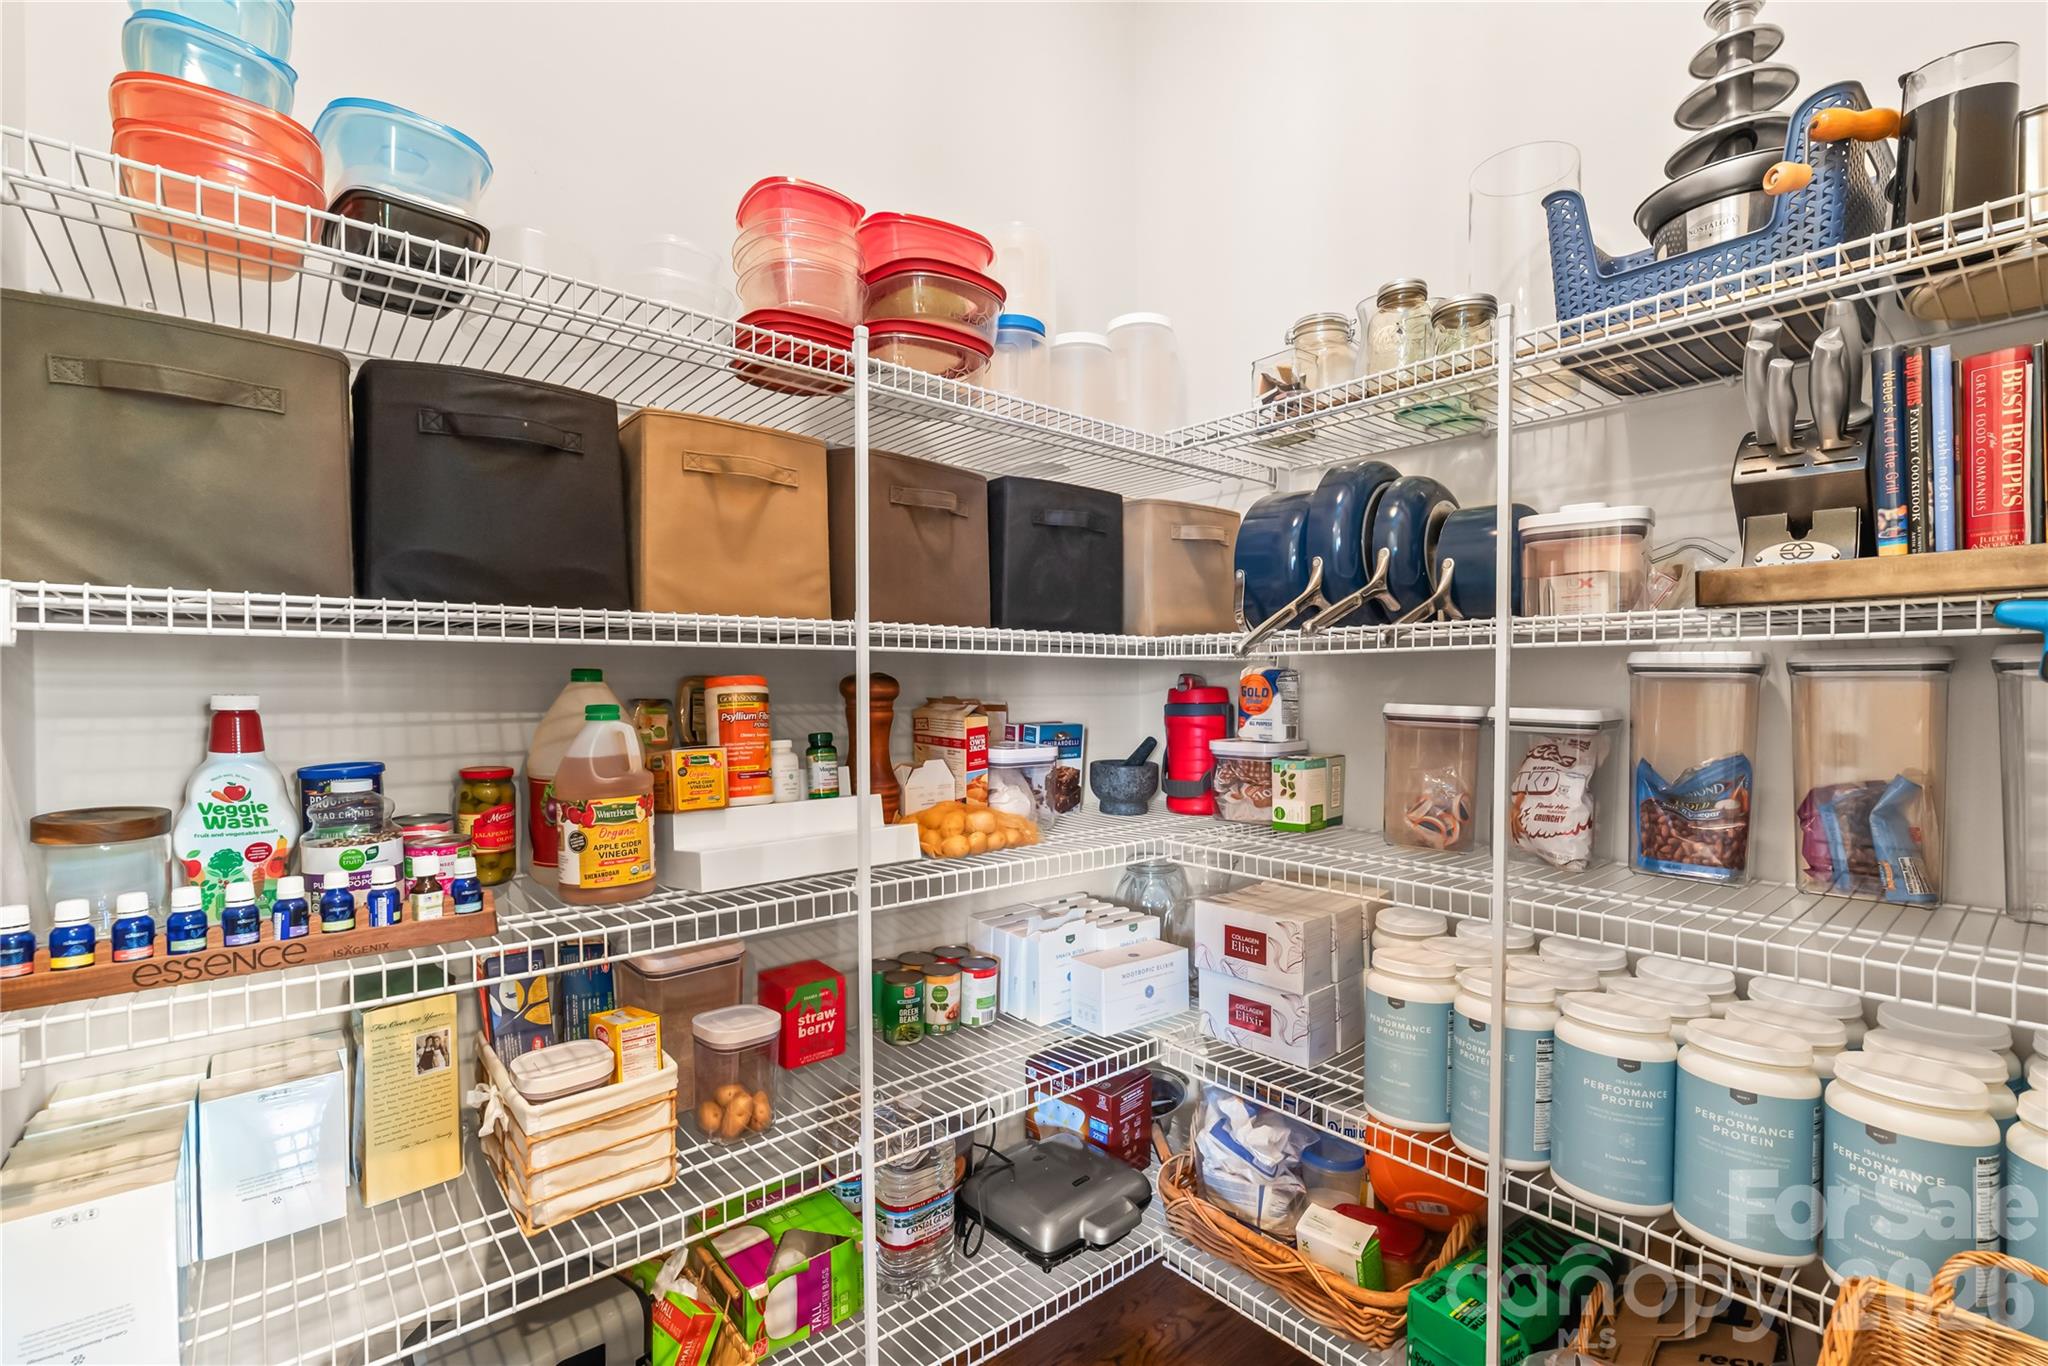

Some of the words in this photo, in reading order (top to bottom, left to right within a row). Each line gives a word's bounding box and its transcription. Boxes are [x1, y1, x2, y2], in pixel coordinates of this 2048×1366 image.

[1688, 215, 1738, 236] NOSTALGIA
[1882, 370, 1896, 414] Weber's
[1975, 374, 1987, 408] GREAT
[2001, 368, 2024, 417] BEST
[1883, 417, 1898, 435] Art
[1909, 408, 1921, 452] FAMILY
[1976, 413, 1987, 444] FOOD
[1884, 439, 1898, 450] of
[1938, 430, 1948, 460] sushi
[1885, 451, 1899, 469] the
[2002, 423, 2024, 508] RECIPES
[1885, 471, 1899, 494] Grill
[1911, 455, 1921, 521] COOKBOOK
[1938, 465, 1949, 512] modern
[1976, 448, 1987, 511] COMPANIES
[1241, 686, 1269, 697] GOLD
[721, 711, 757, 723] Psyllium
[759, 711, 770, 720] Fib
[197, 801, 269, 817] Veggie
[1533, 814, 1566, 823] CRUNCHY
[202, 814, 269, 830] Wash
[225, 830, 259, 838] vegetable
[599, 827, 635, 838] Organic
[593, 843, 619, 851] APPLE
[620, 840, 642, 849] CIDER
[598, 848, 639, 859] VINEGAR
[1231, 933, 1260, 945] COLLAGEN
[1231, 940, 1260, 957] Elixir
[899, 1007, 919, 1016] GREEN
[899, 1014, 919, 1024] BEANS
[1235, 1003, 1264, 1016] COLLAGEN
[1235, 1010, 1265, 1027] Elixir
[798, 1020, 835, 1039] berry
[1369, 1012, 1433, 1034] PERFORMANCE
[1378, 1026, 1416, 1041] PROTEIN
[1583, 1077, 1668, 1099] PERFORMANCE
[1601, 1093, 1654, 1109] PROTEIN
[1695, 1106, 1794, 1139] PERFORMANCE
[1712, 1124, 1774, 1148] PROTEIN
[1832, 1142, 1946, 1188] PERFORMANCE
[1849, 1162, 1918, 1195] PROTEIN
[822, 1267, 830, 1289] BAGS
[812, 1301, 822, 1332] TALL
[820, 1290, 831, 1326] KITCHEN
